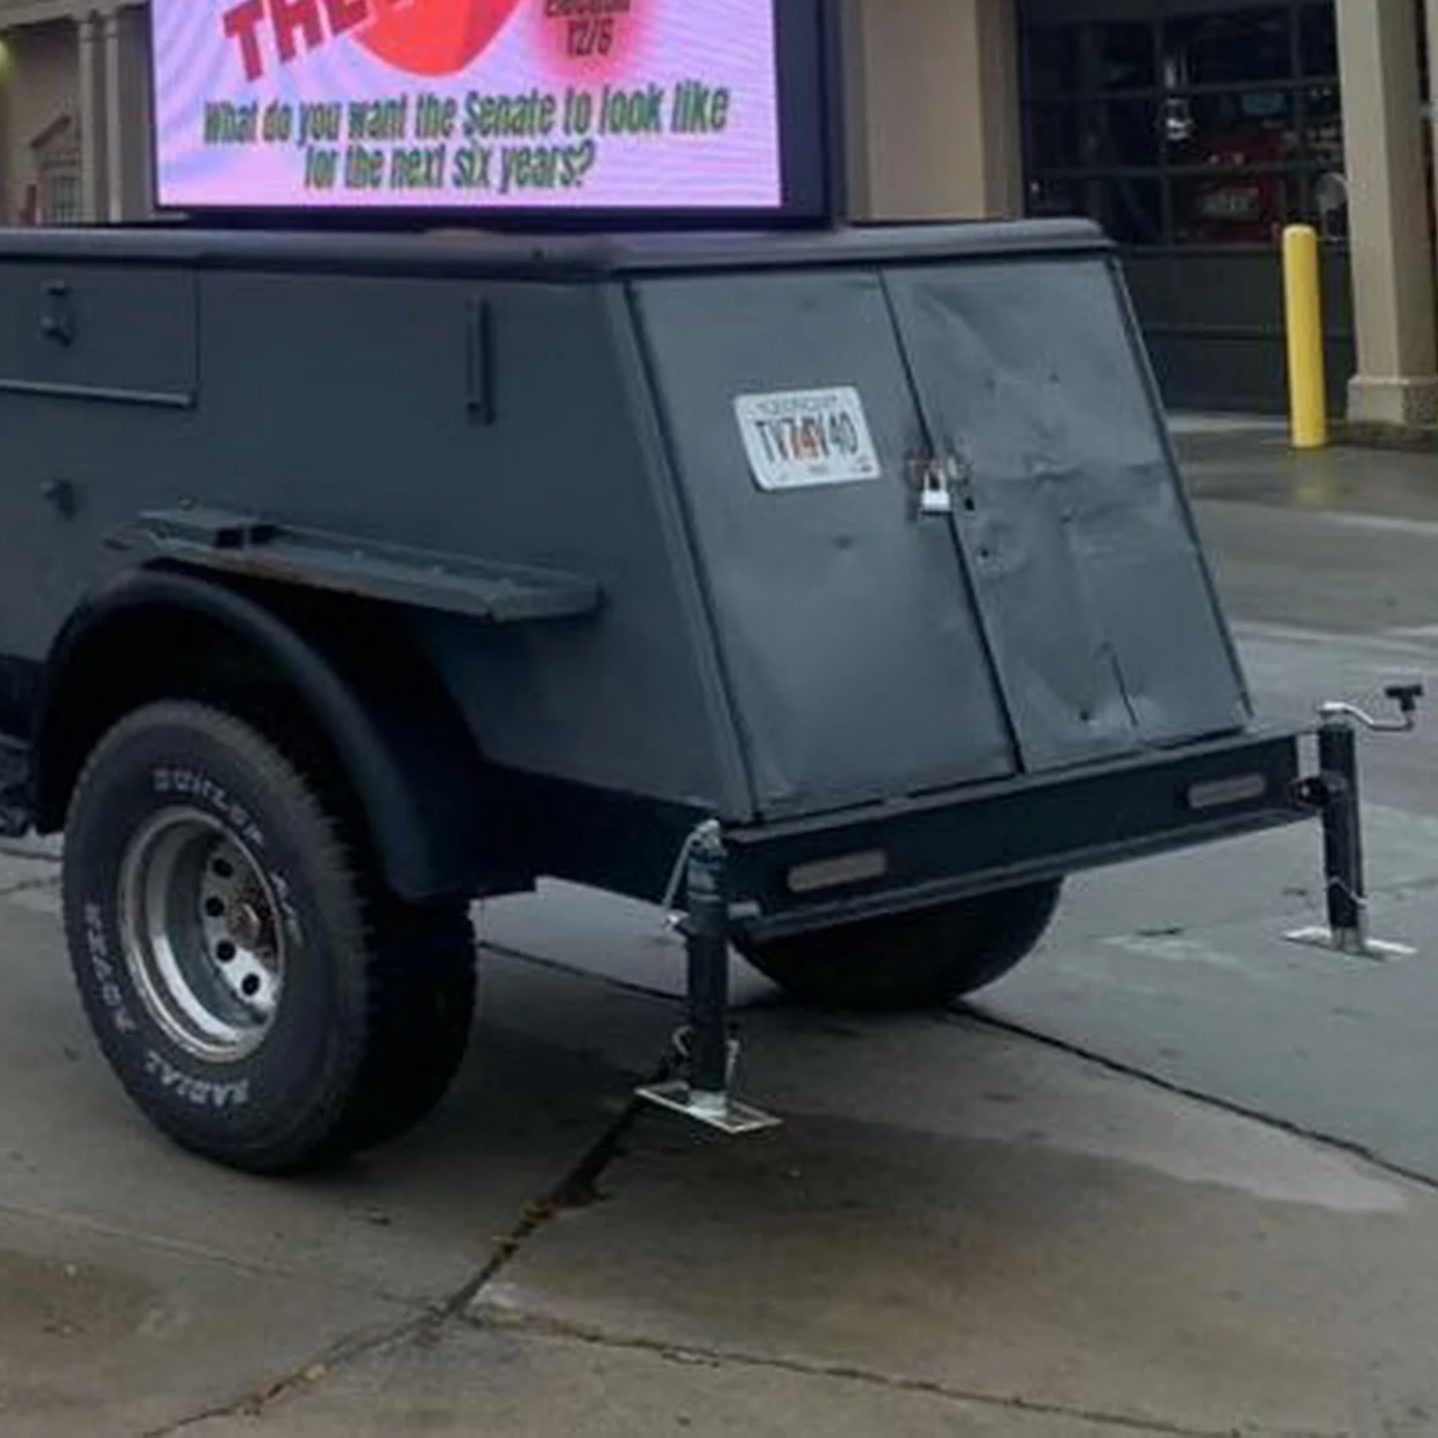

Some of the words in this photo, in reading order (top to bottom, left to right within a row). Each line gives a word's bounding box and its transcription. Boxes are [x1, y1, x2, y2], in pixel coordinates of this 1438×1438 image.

[262, 97, 292, 142] do
[297, 102, 341, 148] you
[347, 92, 408, 139] want
[415, 90, 456, 140] the
[463, 89, 555, 137] Senate
[563, 86, 591, 135] to
[598, 83, 663, 133] look
[670, 79, 729, 133] like
[304, 144, 339, 189] for
[344, 142, 384, 189] the
[390, 142, 445, 189] next
[453, 144, 490, 188] six
[498, 139, 595, 194] years?
